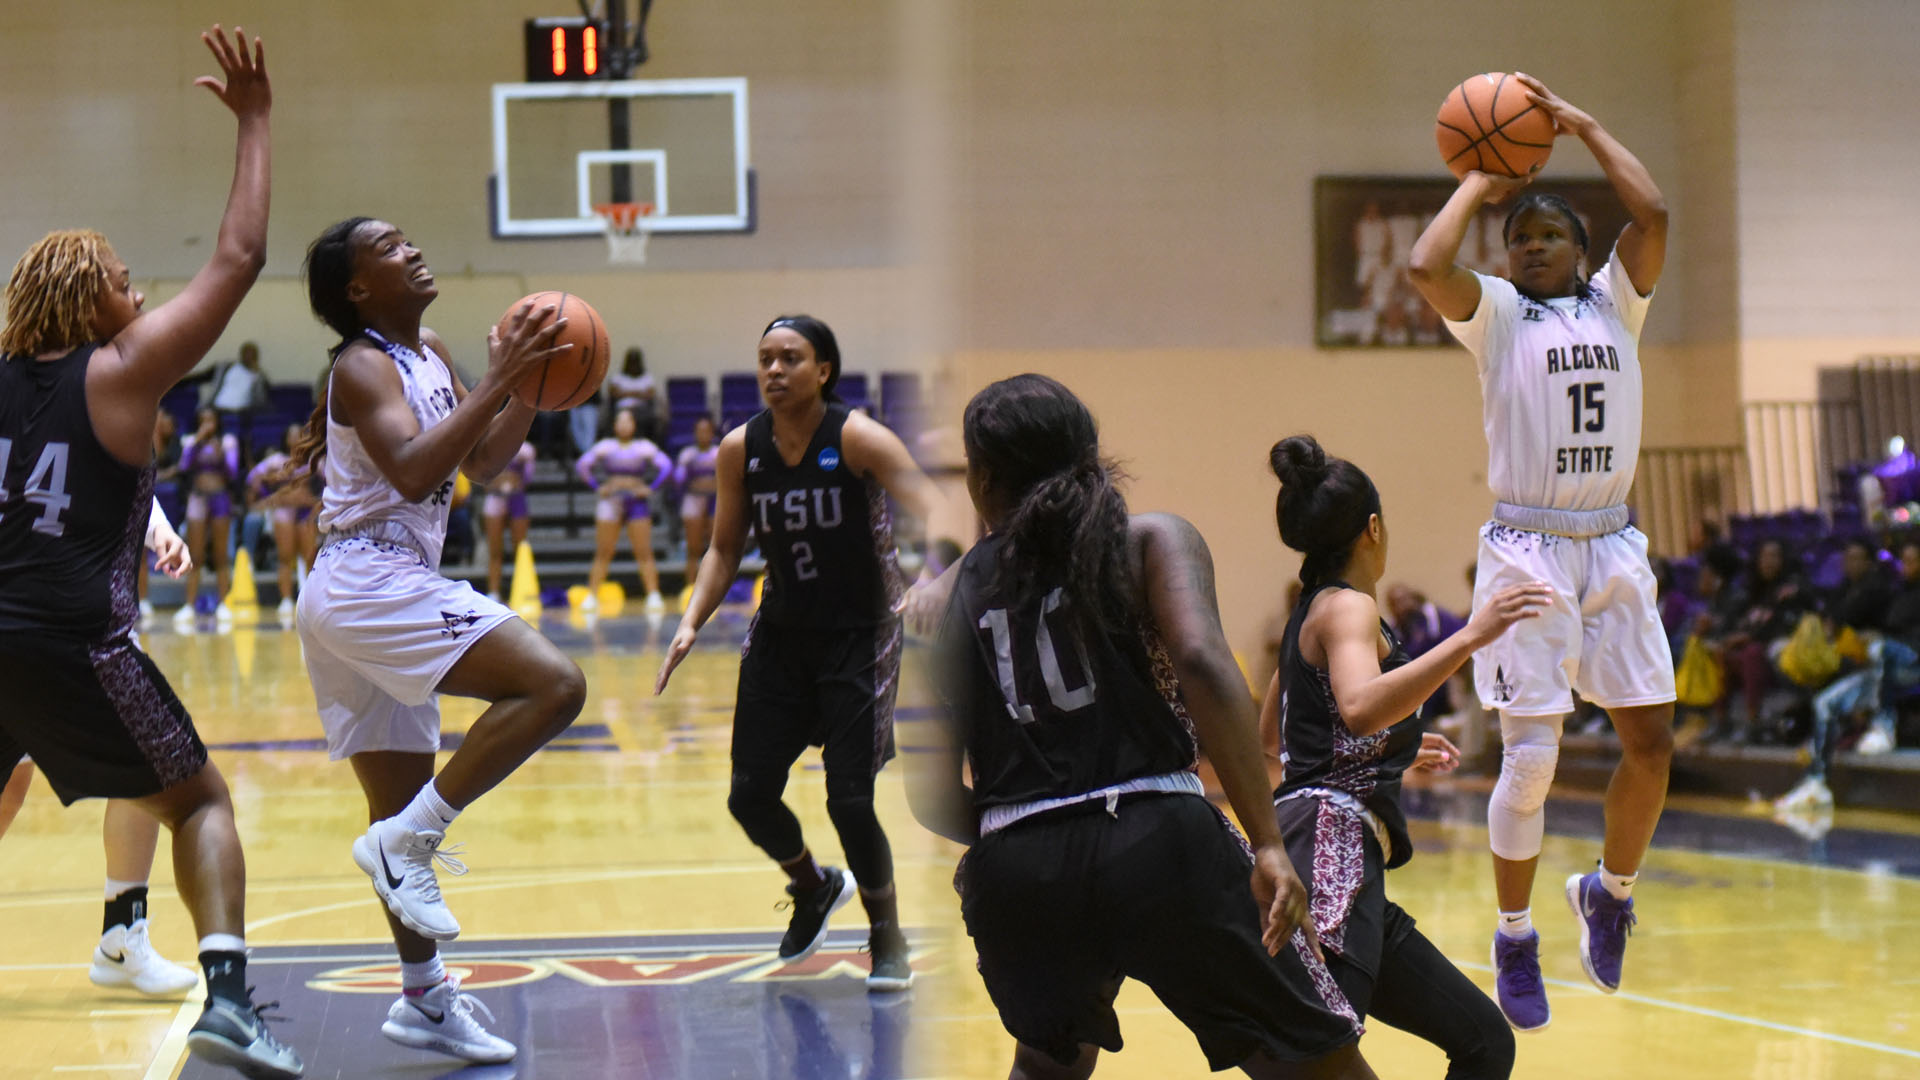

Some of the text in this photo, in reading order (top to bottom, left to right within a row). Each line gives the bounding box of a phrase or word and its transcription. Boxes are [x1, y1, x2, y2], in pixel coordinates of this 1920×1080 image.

[551, 26, 598, 76] 11
[1546, 344, 1620, 375] ALCORN
[1566, 382, 1606, 434] 15
[1556, 446, 1614, 474] STATE
[752, 487, 843, 533] TSU
[791, 541, 818, 580] 2
[979, 587, 1096, 724] 10
